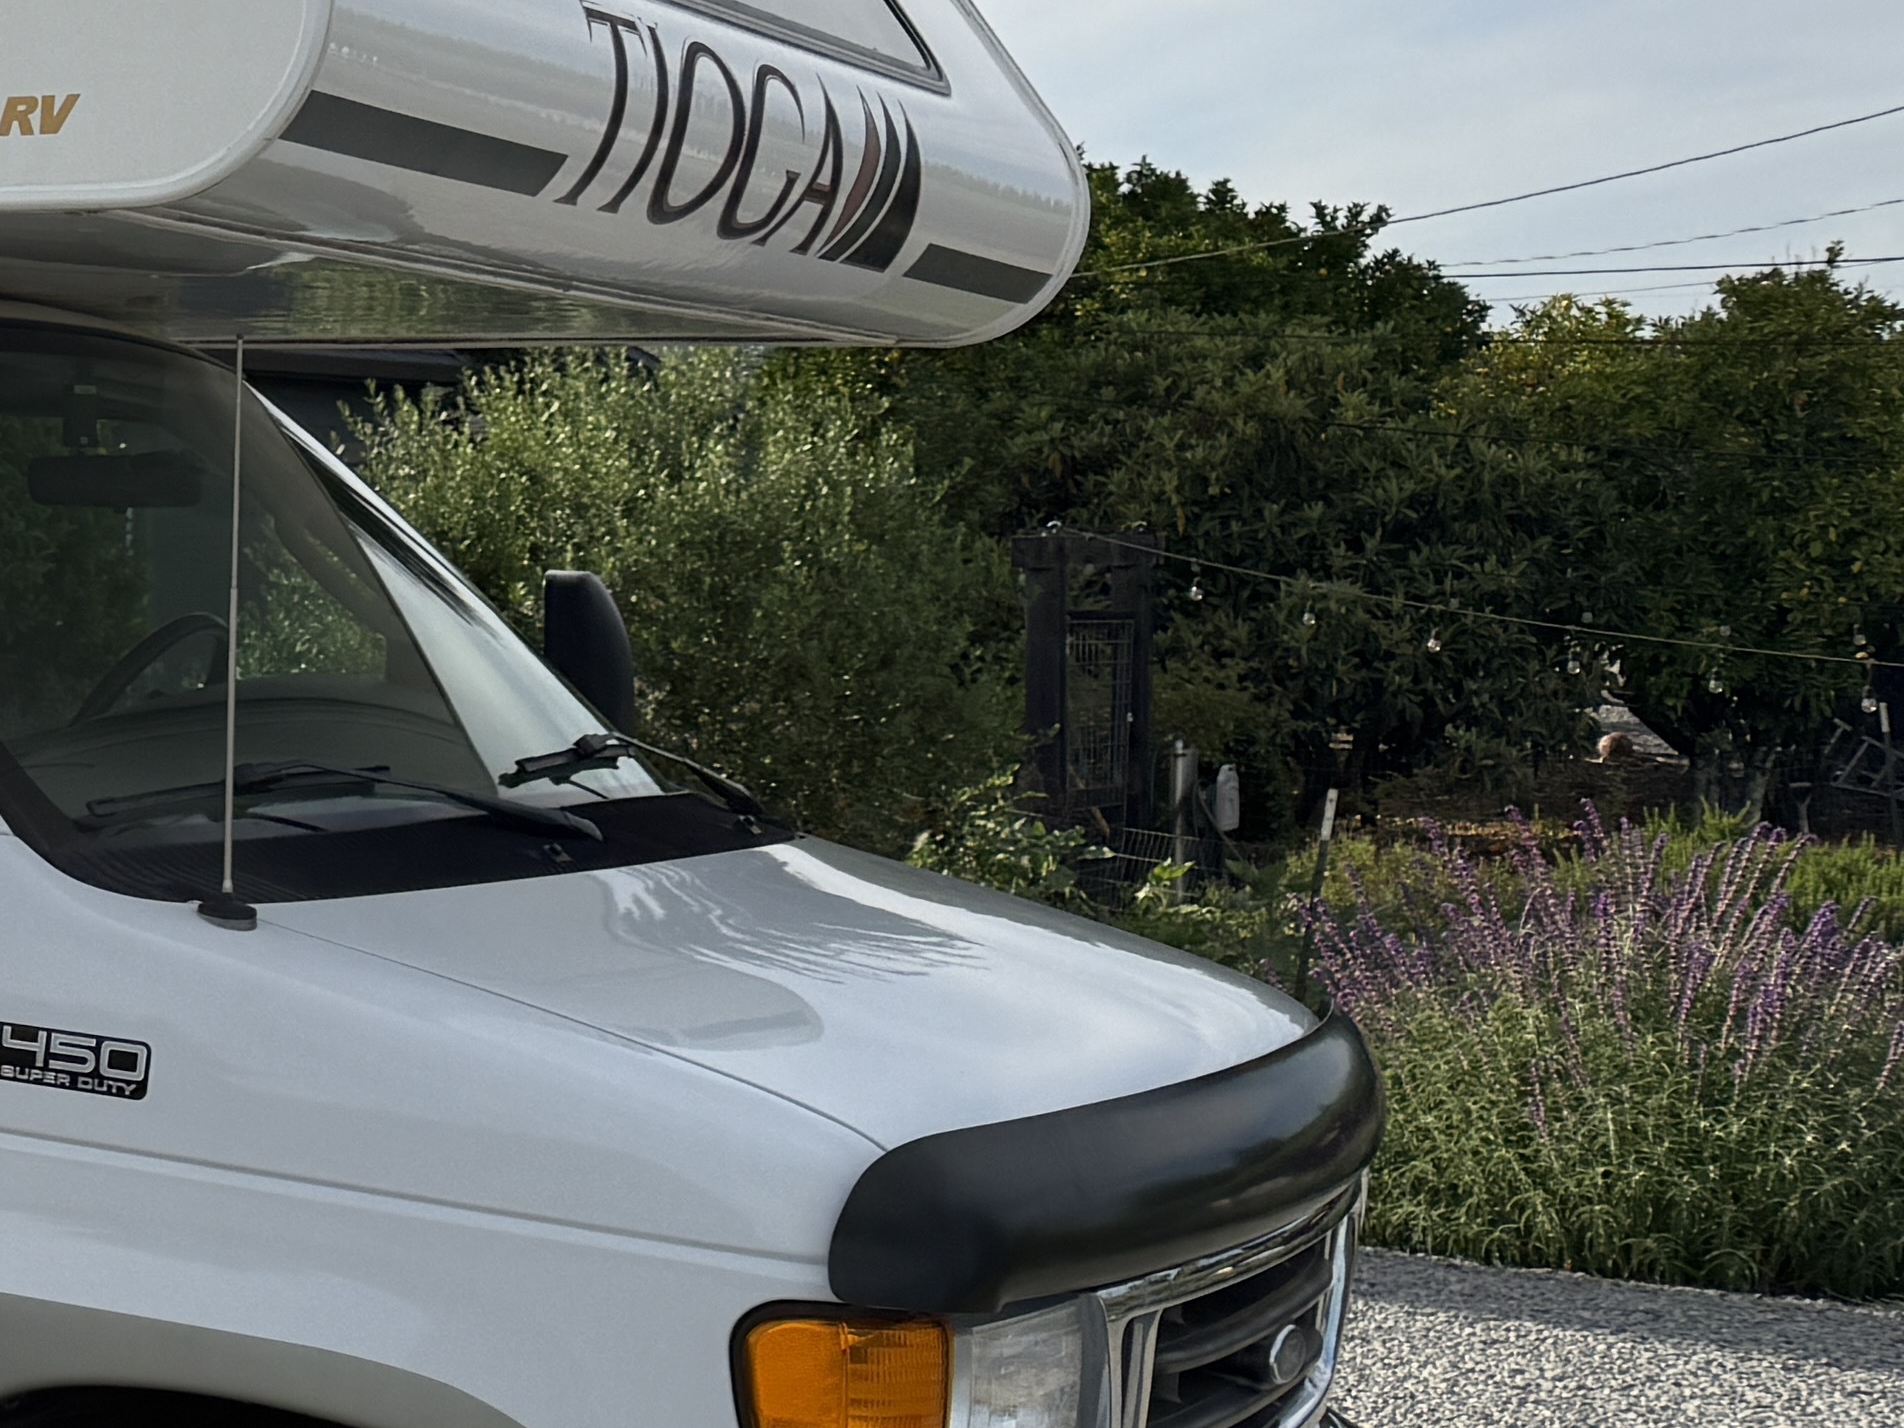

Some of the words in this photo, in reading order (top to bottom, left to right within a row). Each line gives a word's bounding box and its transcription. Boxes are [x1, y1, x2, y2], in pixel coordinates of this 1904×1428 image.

[553, 0, 844, 256] TIOGA
[0, 1064, 71, 1087] SUPER
[77, 1077, 137, 1097] DUTY
